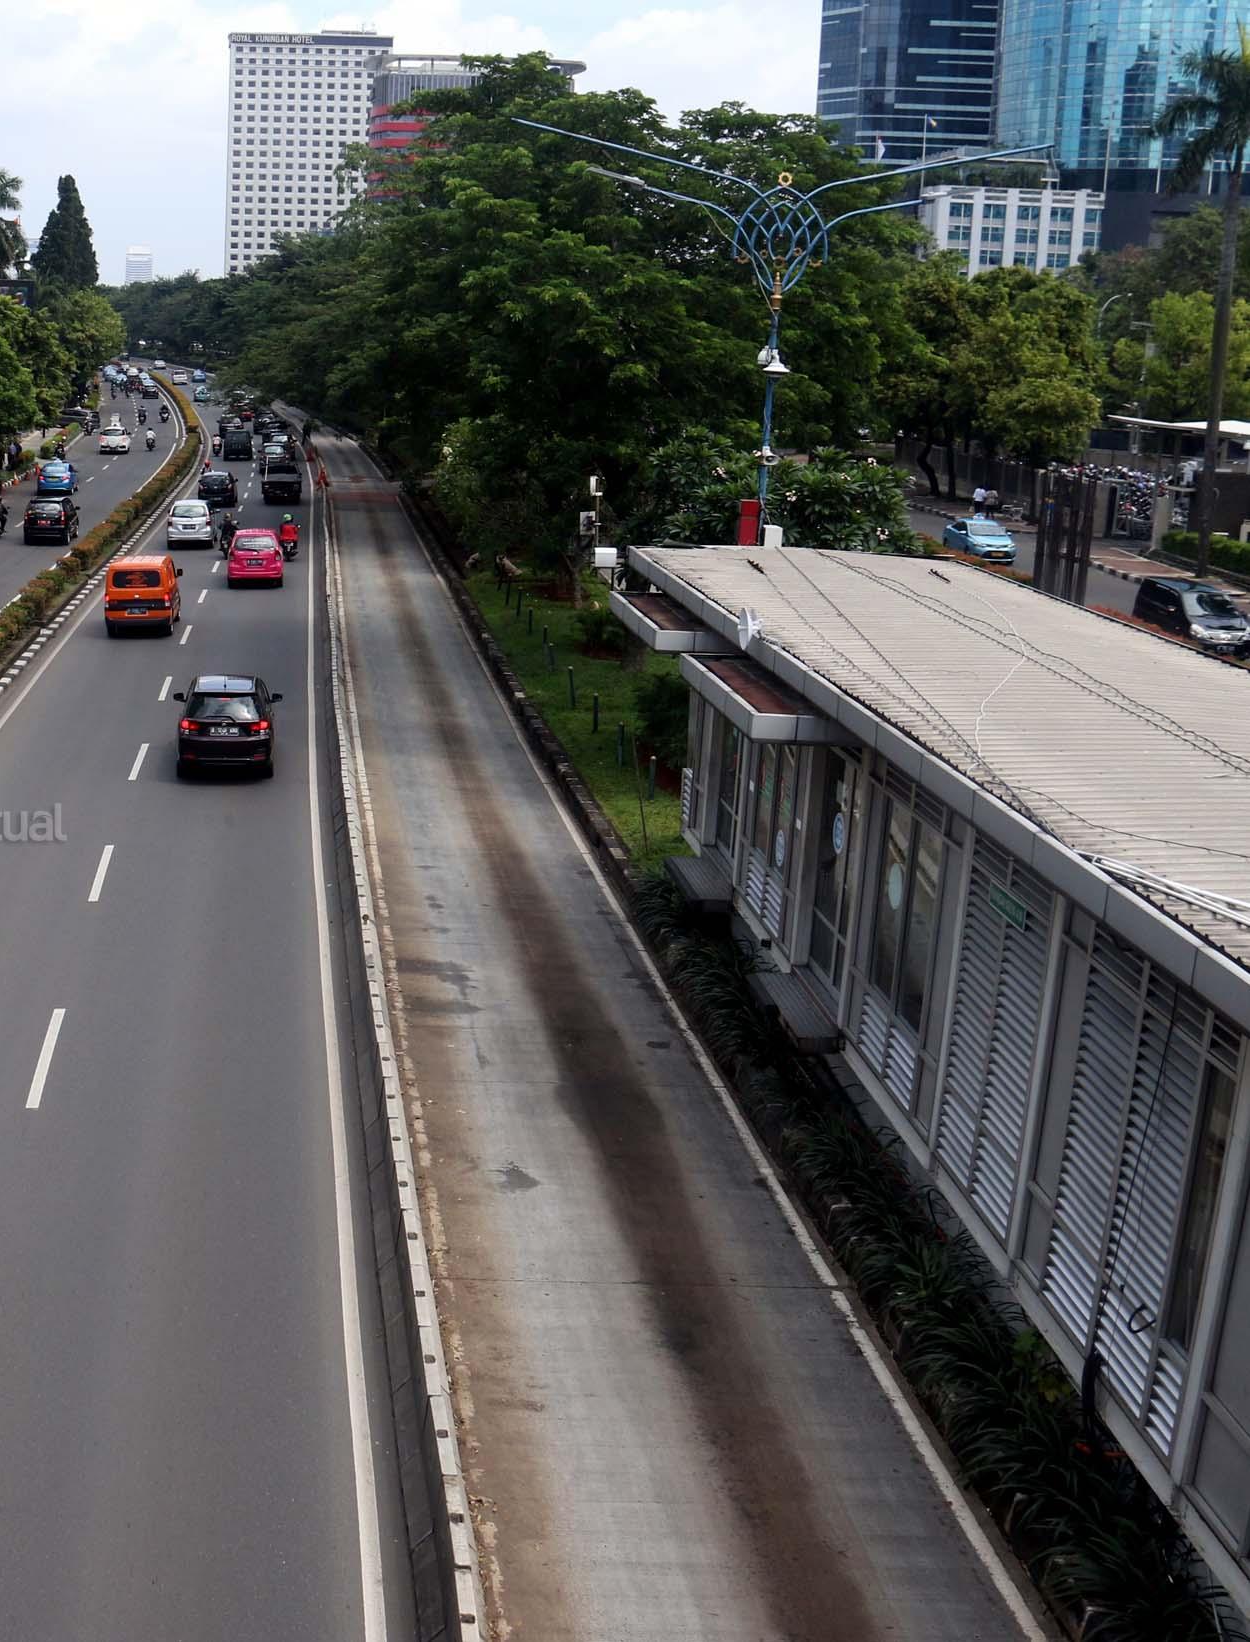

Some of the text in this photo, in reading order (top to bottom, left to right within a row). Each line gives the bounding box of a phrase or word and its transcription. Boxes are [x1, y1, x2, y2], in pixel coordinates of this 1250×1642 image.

[230, 33, 315, 44] ROYAL KUNINGAN HOTEL
